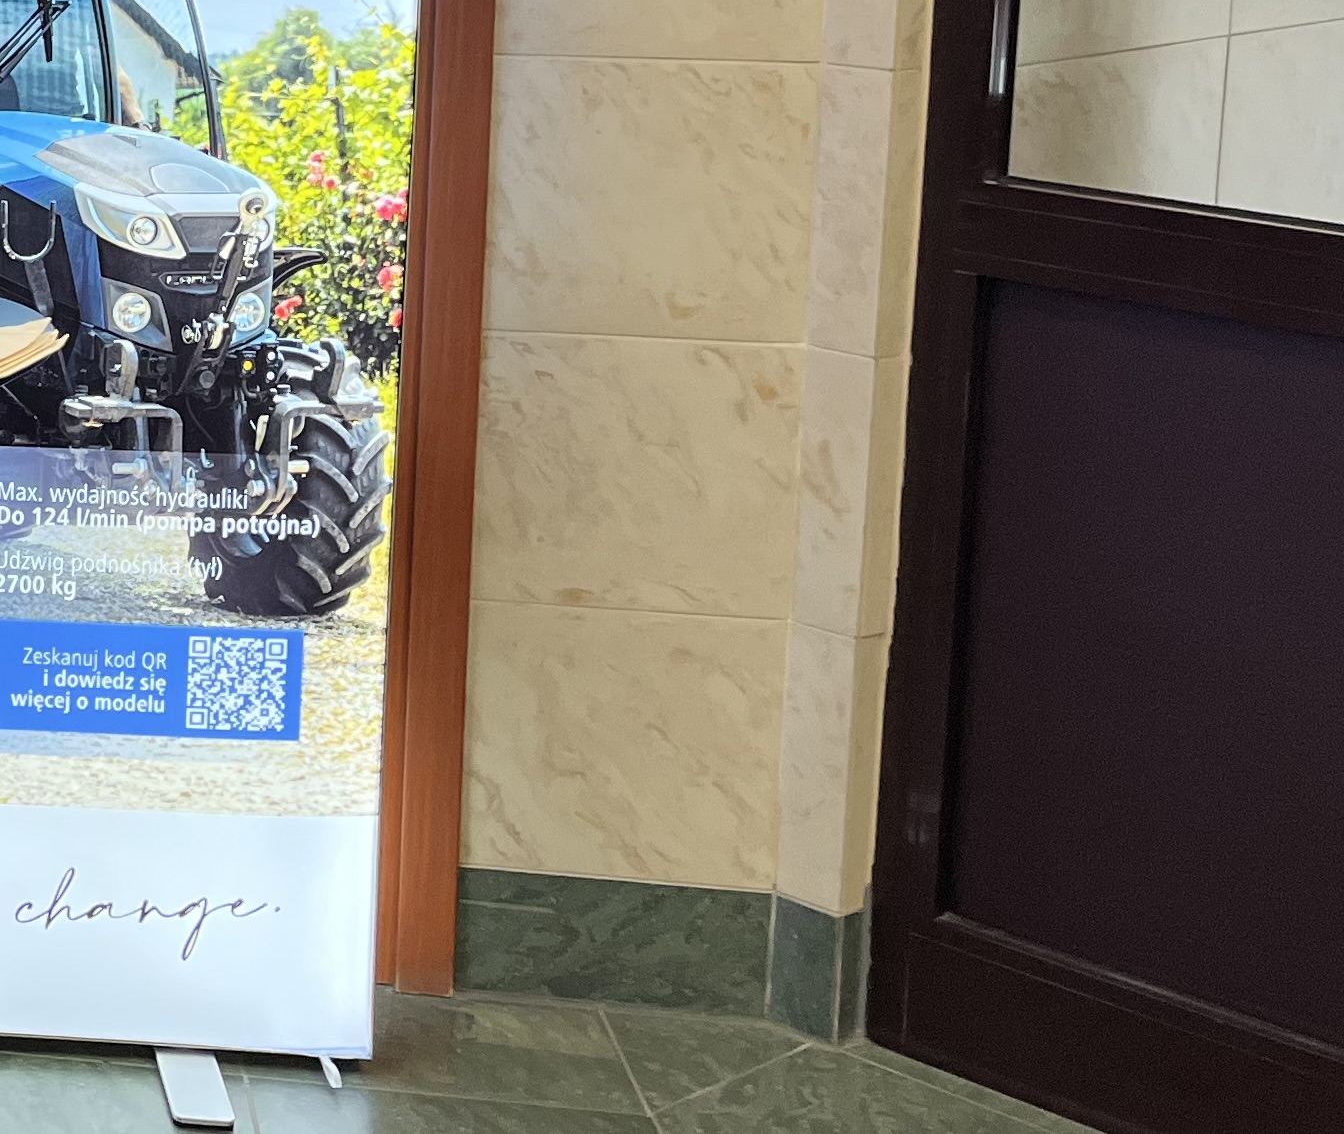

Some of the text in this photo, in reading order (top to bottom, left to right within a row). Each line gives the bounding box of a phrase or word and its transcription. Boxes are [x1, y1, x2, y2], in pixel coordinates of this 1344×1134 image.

[50, 483, 150, 509] wydajność
[155, 486, 249, 512] hydrauliki
[32, 507, 70, 526] 124
[76, 507, 128, 528] l/min
[136, 509, 216, 537] (pompa
[222, 513, 320, 541] potrójna)
[188, 555, 223, 581] (tył)
[51, 573, 77, 601] kg
[22, 646, 167, 672] Zeskanuj kod QR
[43, 668, 167, 696] i dowiedz się
[10, 689, 165, 714] więcej o modelu
